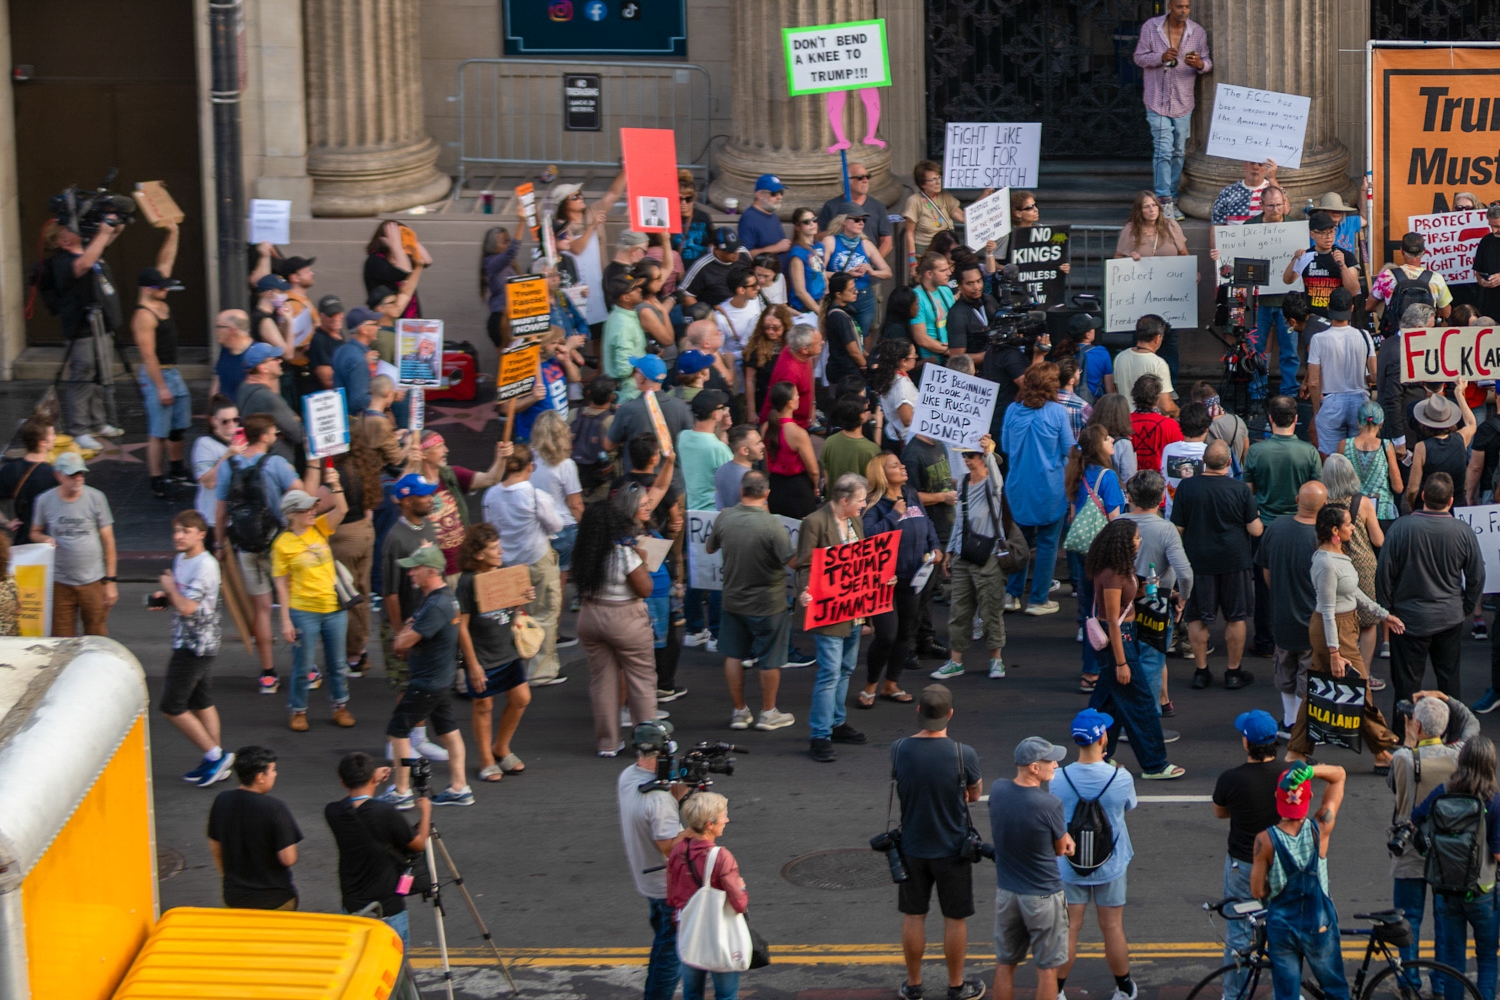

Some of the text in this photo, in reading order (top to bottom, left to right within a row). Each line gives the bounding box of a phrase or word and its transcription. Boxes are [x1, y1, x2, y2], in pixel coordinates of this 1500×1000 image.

[793, 33, 868, 50] DON'T BEND
[795, 49, 861, 65] A KNEE TO
[811, 67, 868, 82] TRUMP!!!
[1223, 87, 1241, 98] The
[1278, 97, 1293, 107] has
[1218, 113, 1230, 121] the
[1211, 131, 1236, 146] Bring
[1245, 135, 1271, 147] Back
[992, 146, 1018, 166] FOR
[950, 167, 1027, 187] FREE SPEECH
[1414, 211, 1472, 232] PROTECT
[1029, 227, 1051, 243] NO
[1219, 230, 1236, 239] The
[1222, 240, 1247, 250] must
[1012, 245, 1062, 264] KINGS
[1018, 270, 1057, 283] UNLESS
[1112, 265, 1184, 286] Protect our
[1109, 290, 1190, 309] First Amendment
[511, 314, 550, 326] MUST GO
[1109, 313, 1138, 326] Freedo
[931, 370, 948, 384] IT'S
[925, 383, 991, 407] TO LOOK A LOT
[922, 393, 981, 417] LIKE RUSSIA
[931, 410, 971, 429] DUMP
[921, 420, 968, 443] DISNEY
[824, 533, 893, 567] SCREW
[823, 549, 892, 586] TRUMP
[1331, 713, 1361, 730] LAND
